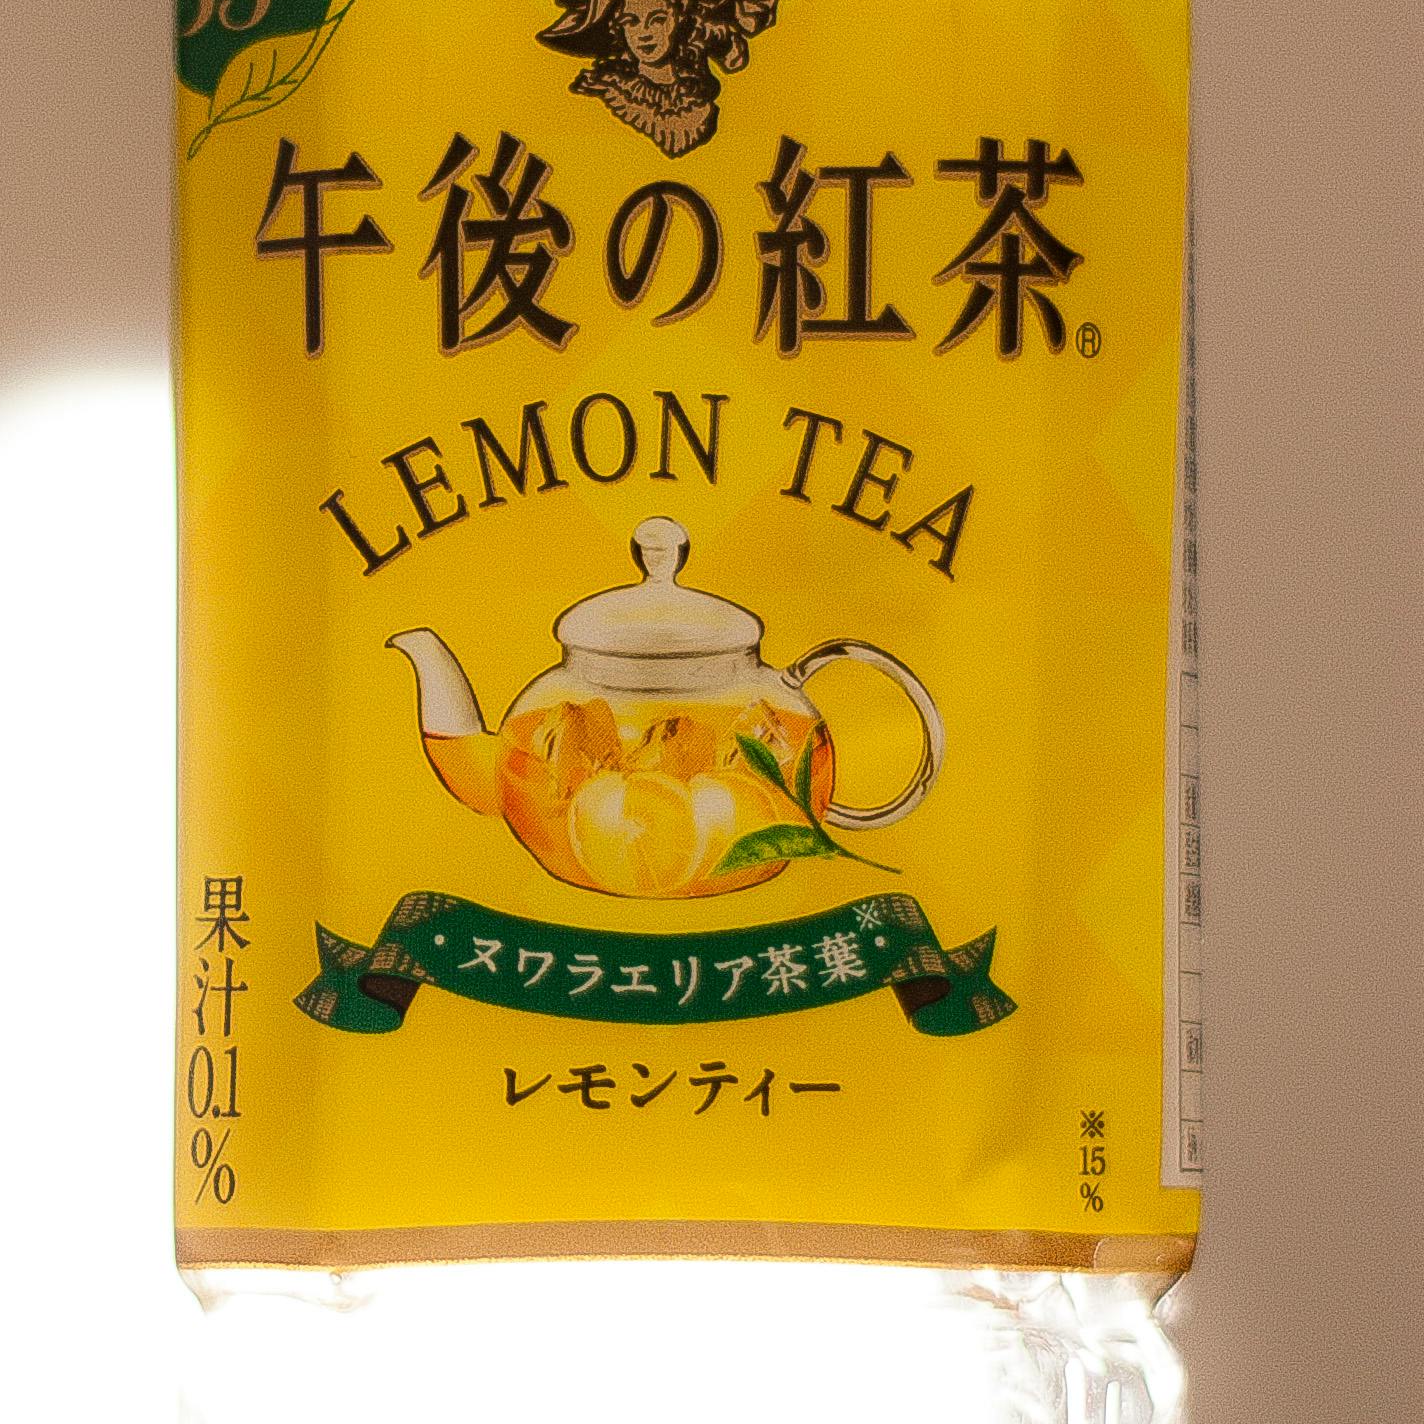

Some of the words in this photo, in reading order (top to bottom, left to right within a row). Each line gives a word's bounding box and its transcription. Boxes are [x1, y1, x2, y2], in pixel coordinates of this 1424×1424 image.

[319, 390, 729, 578] LEMON
[780, 406, 975, 581] TEA
[503, 1060, 842, 1117] レモンティー
